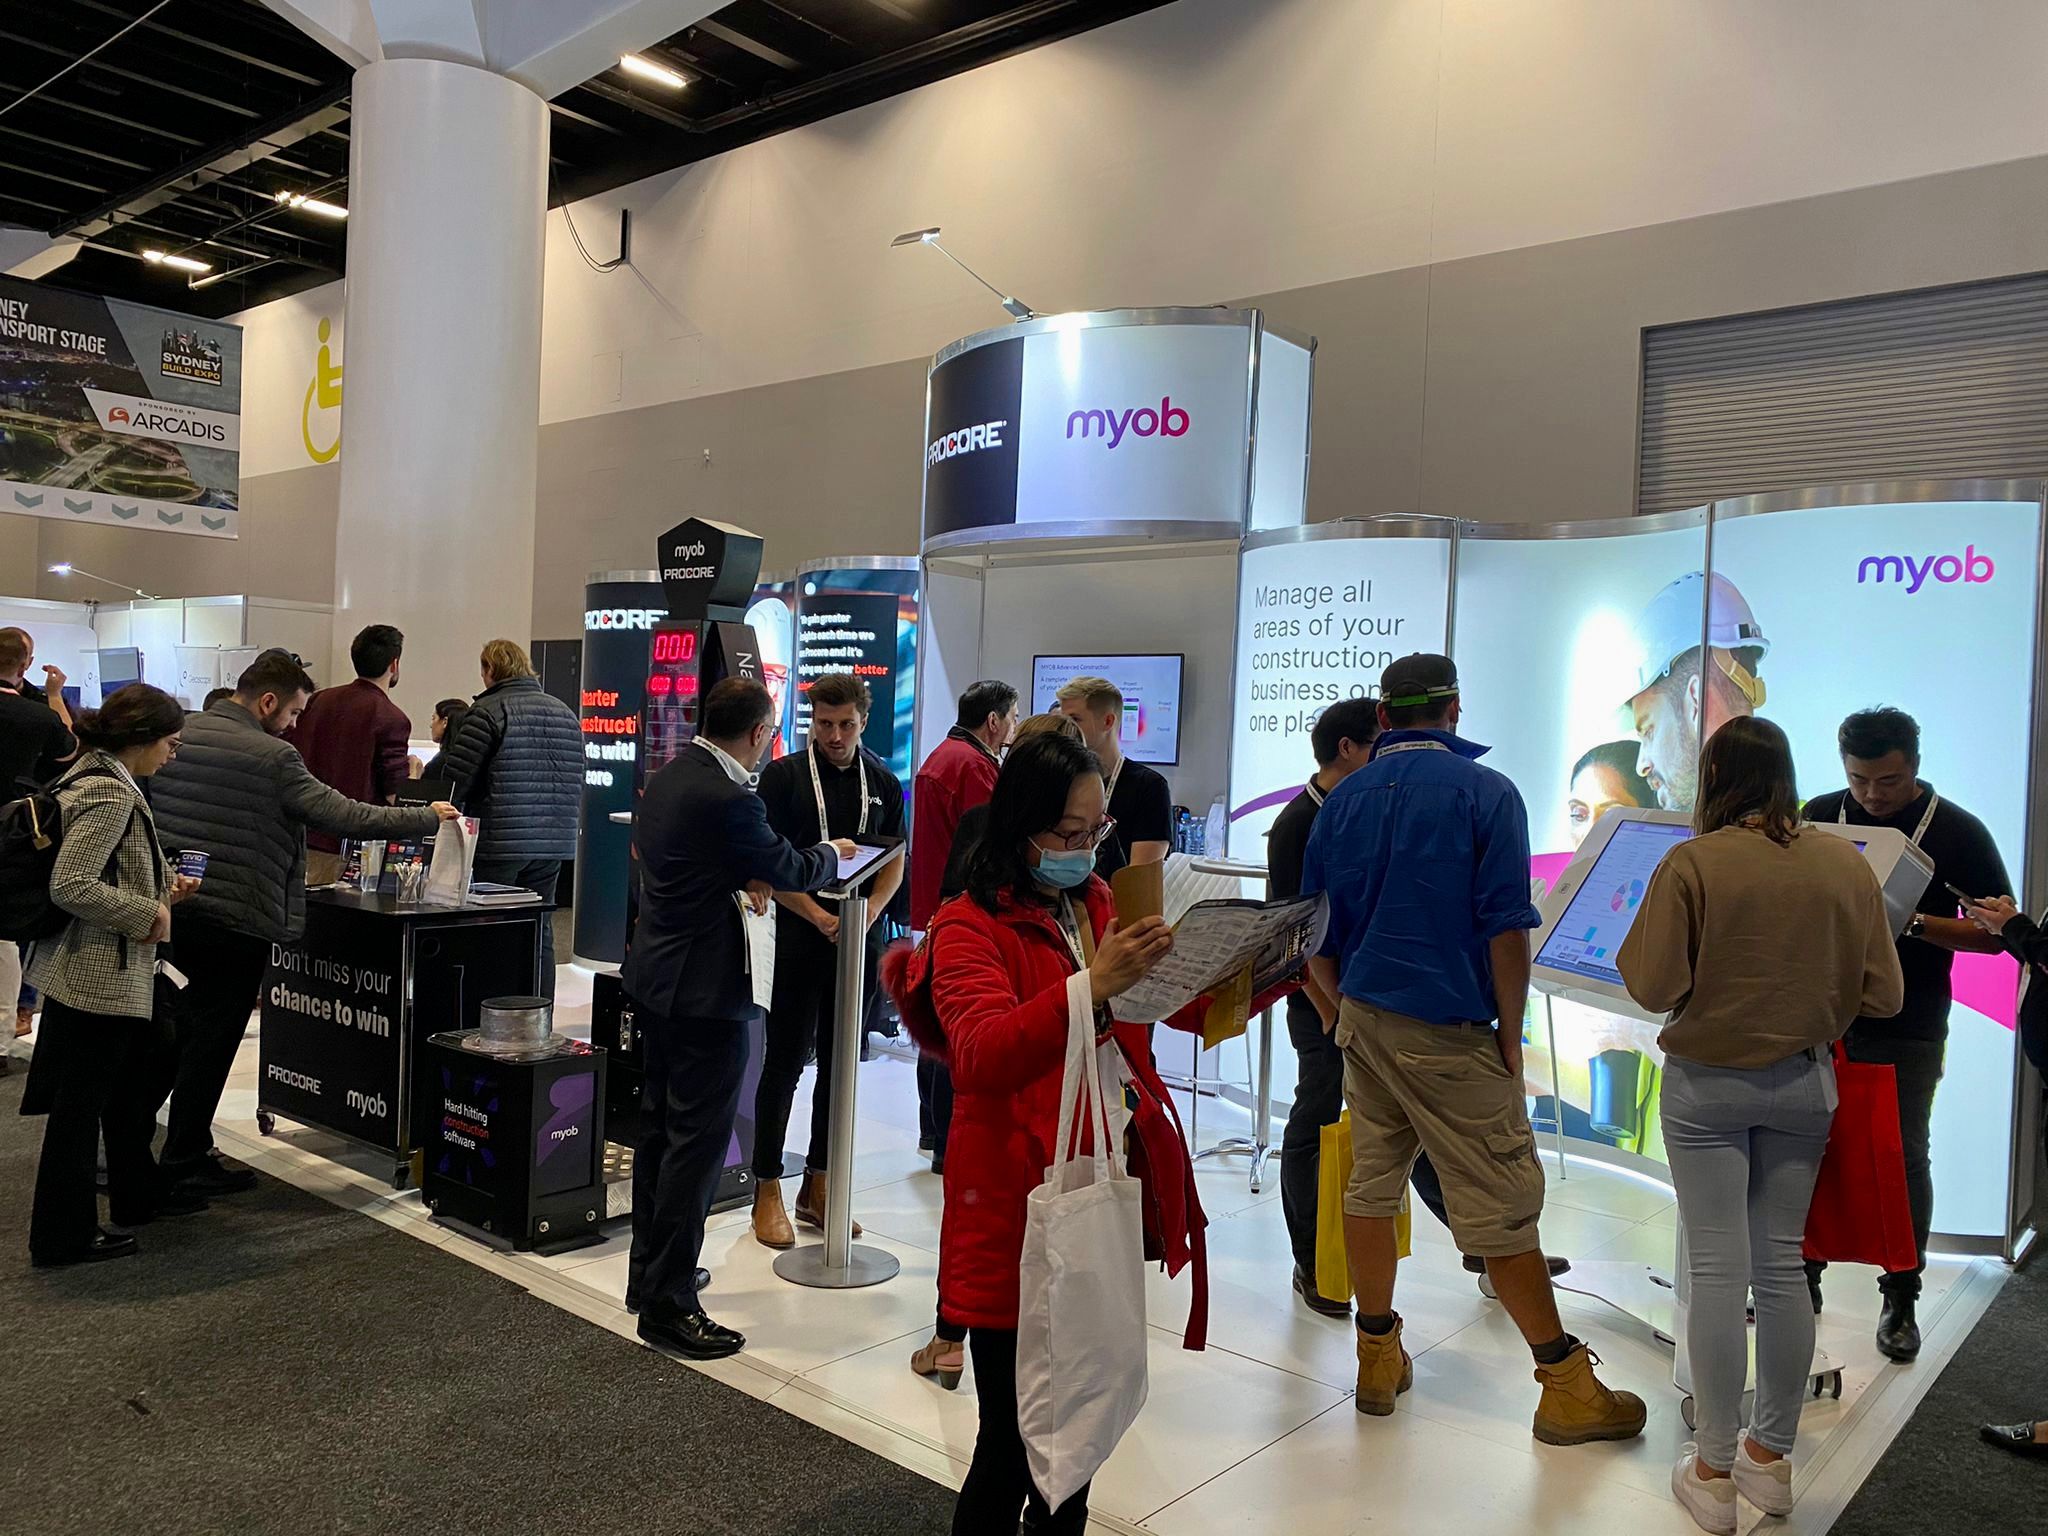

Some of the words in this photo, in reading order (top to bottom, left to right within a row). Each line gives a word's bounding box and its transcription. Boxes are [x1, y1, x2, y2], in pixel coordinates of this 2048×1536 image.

[60, 329, 106, 355] STAGE
[162, 351, 221, 372] SYDNEY
[162, 362, 191, 374] BUILD
[194, 368, 221, 380] EXPO
[132, 412, 225, 441] ARCADIS
[1066, 396, 1190, 449] myob
[674, 540, 705, 561] myob
[664, 566, 715, 580] PROCORE
[1857, 544, 1995, 595] myob
[1255, 584, 1334, 610] Manage
[1342, 579, 1372, 603] all
[820, 613, 851, 626] greater
[1253, 618, 1300, 639] areas
[1308, 612, 1334, 636] of
[1342, 617, 1405, 641] your
[654, 633, 695, 661] 000
[836, 629, 858, 640] time
[859, 631, 876, 641] we
[829, 646, 847, 657] and
[847, 646, 864, 658] it's
[1252, 645, 1392, 670] construction
[854, 664, 888, 675] better
[1250, 678, 1339, 701] business
[1250, 712, 1278, 733] one
[1284, 710, 1316, 738] pla
[272, 942, 309, 975] Don't
[314, 955, 349, 985] miss
[355, 967, 391, 995] your
[271, 983, 331, 1021] chance
[335, 999, 352, 1026] to
[356, 1005, 389, 1037] win
[268, 1064, 322, 1095] PROCORE
[346, 1089, 387, 1118] myob
[444, 1097, 463, 1115] Hard
[463, 1104, 488, 1126] hitting
[443, 1115, 489, 1139] construction
[551, 1125, 579, 1141] myob
[443, 1130, 476, 1150] software
